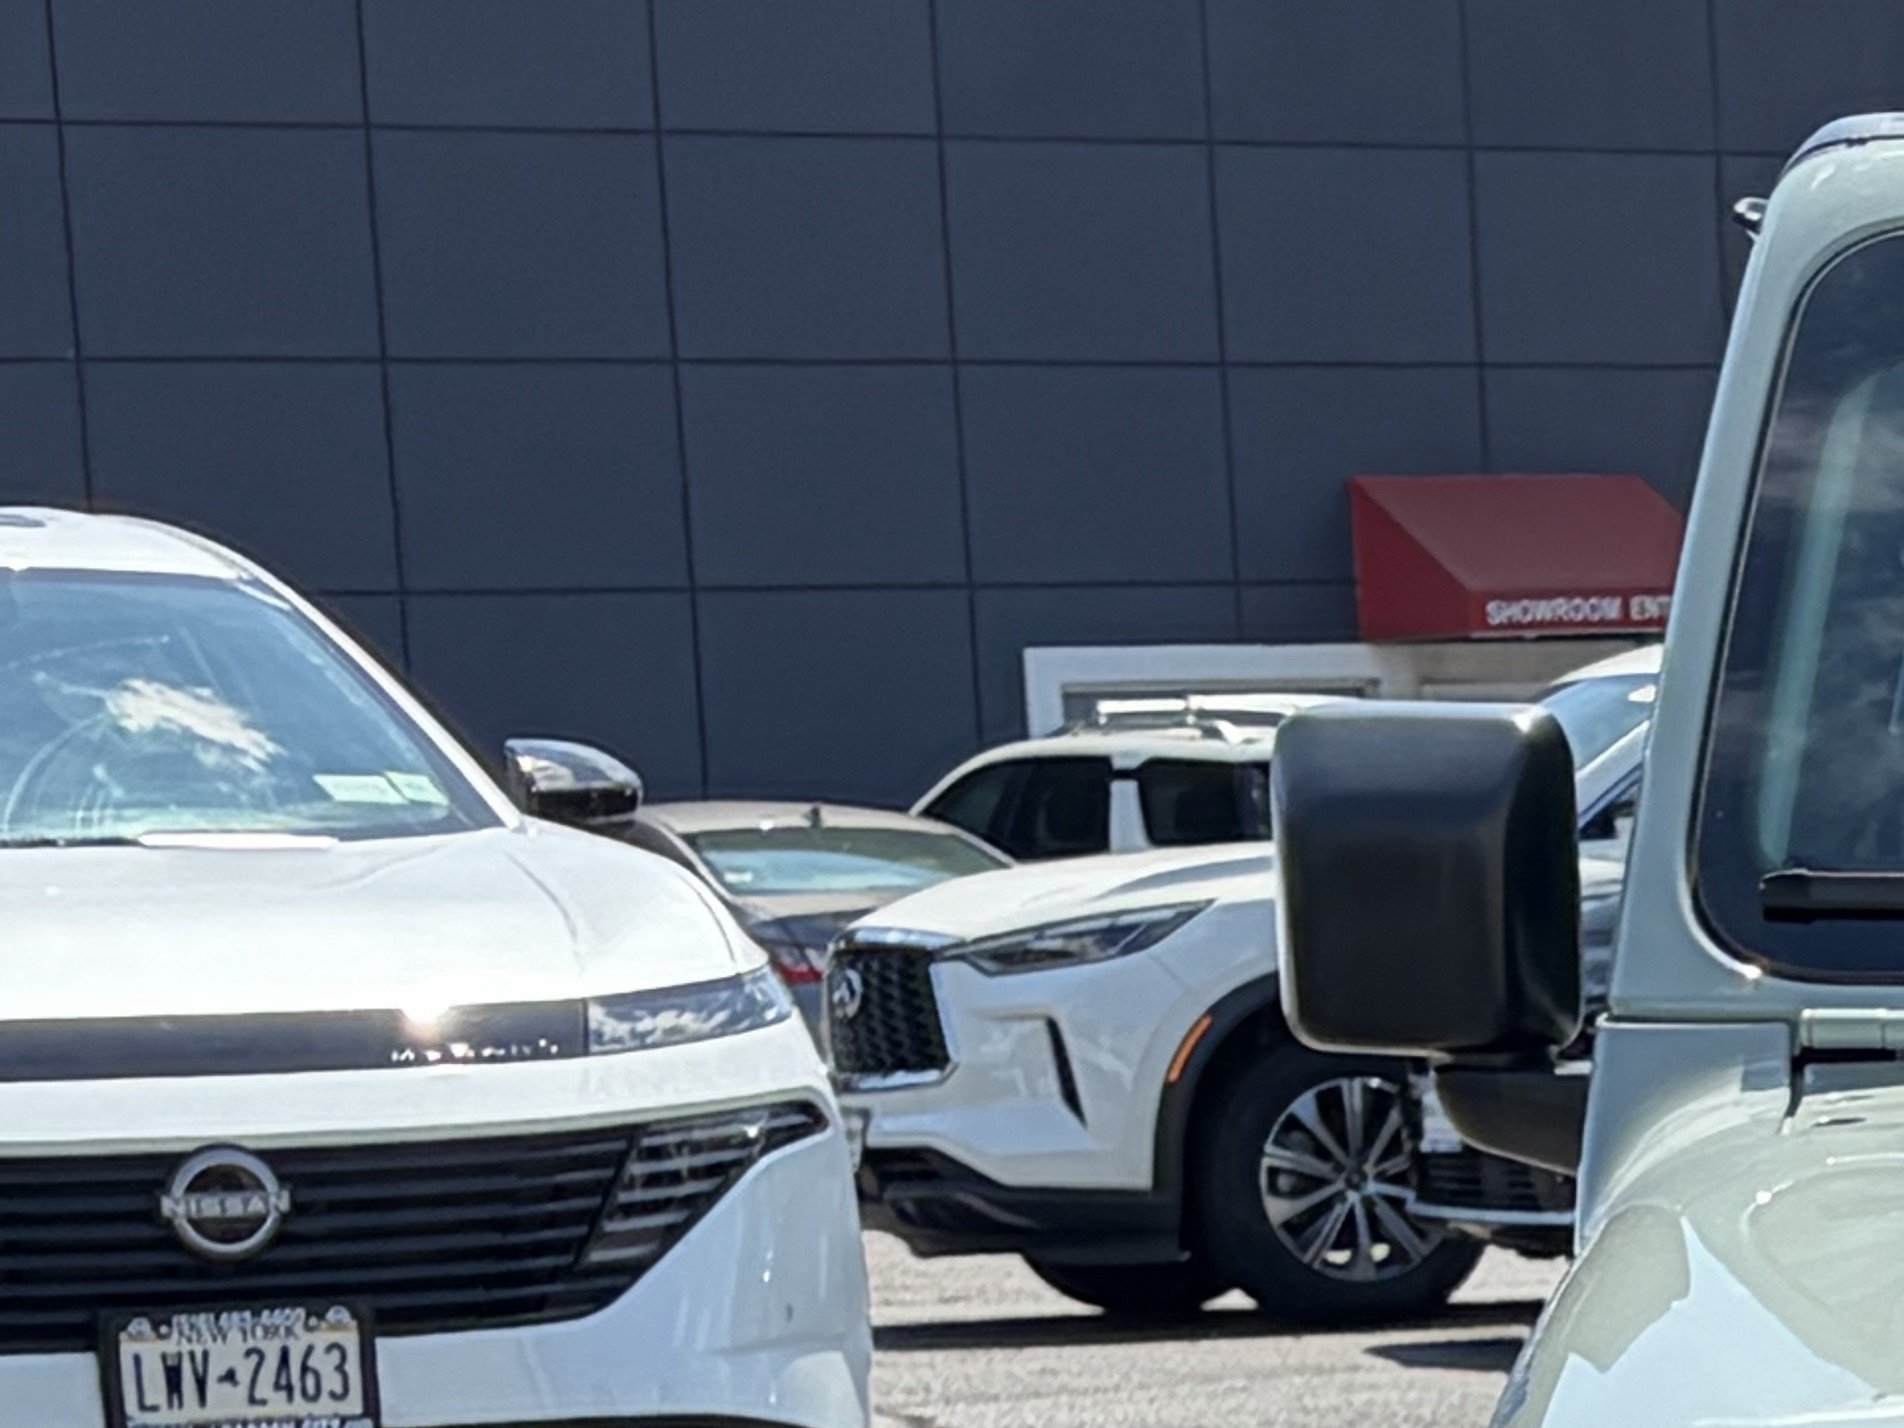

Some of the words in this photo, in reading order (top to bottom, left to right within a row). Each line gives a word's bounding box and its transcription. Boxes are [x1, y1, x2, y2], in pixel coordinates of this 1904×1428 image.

[1485, 597, 1622, 625] SHOWROOM
[160, 1189, 291, 1218] NISSAN
[245, 1341, 350, 1407] 2463
